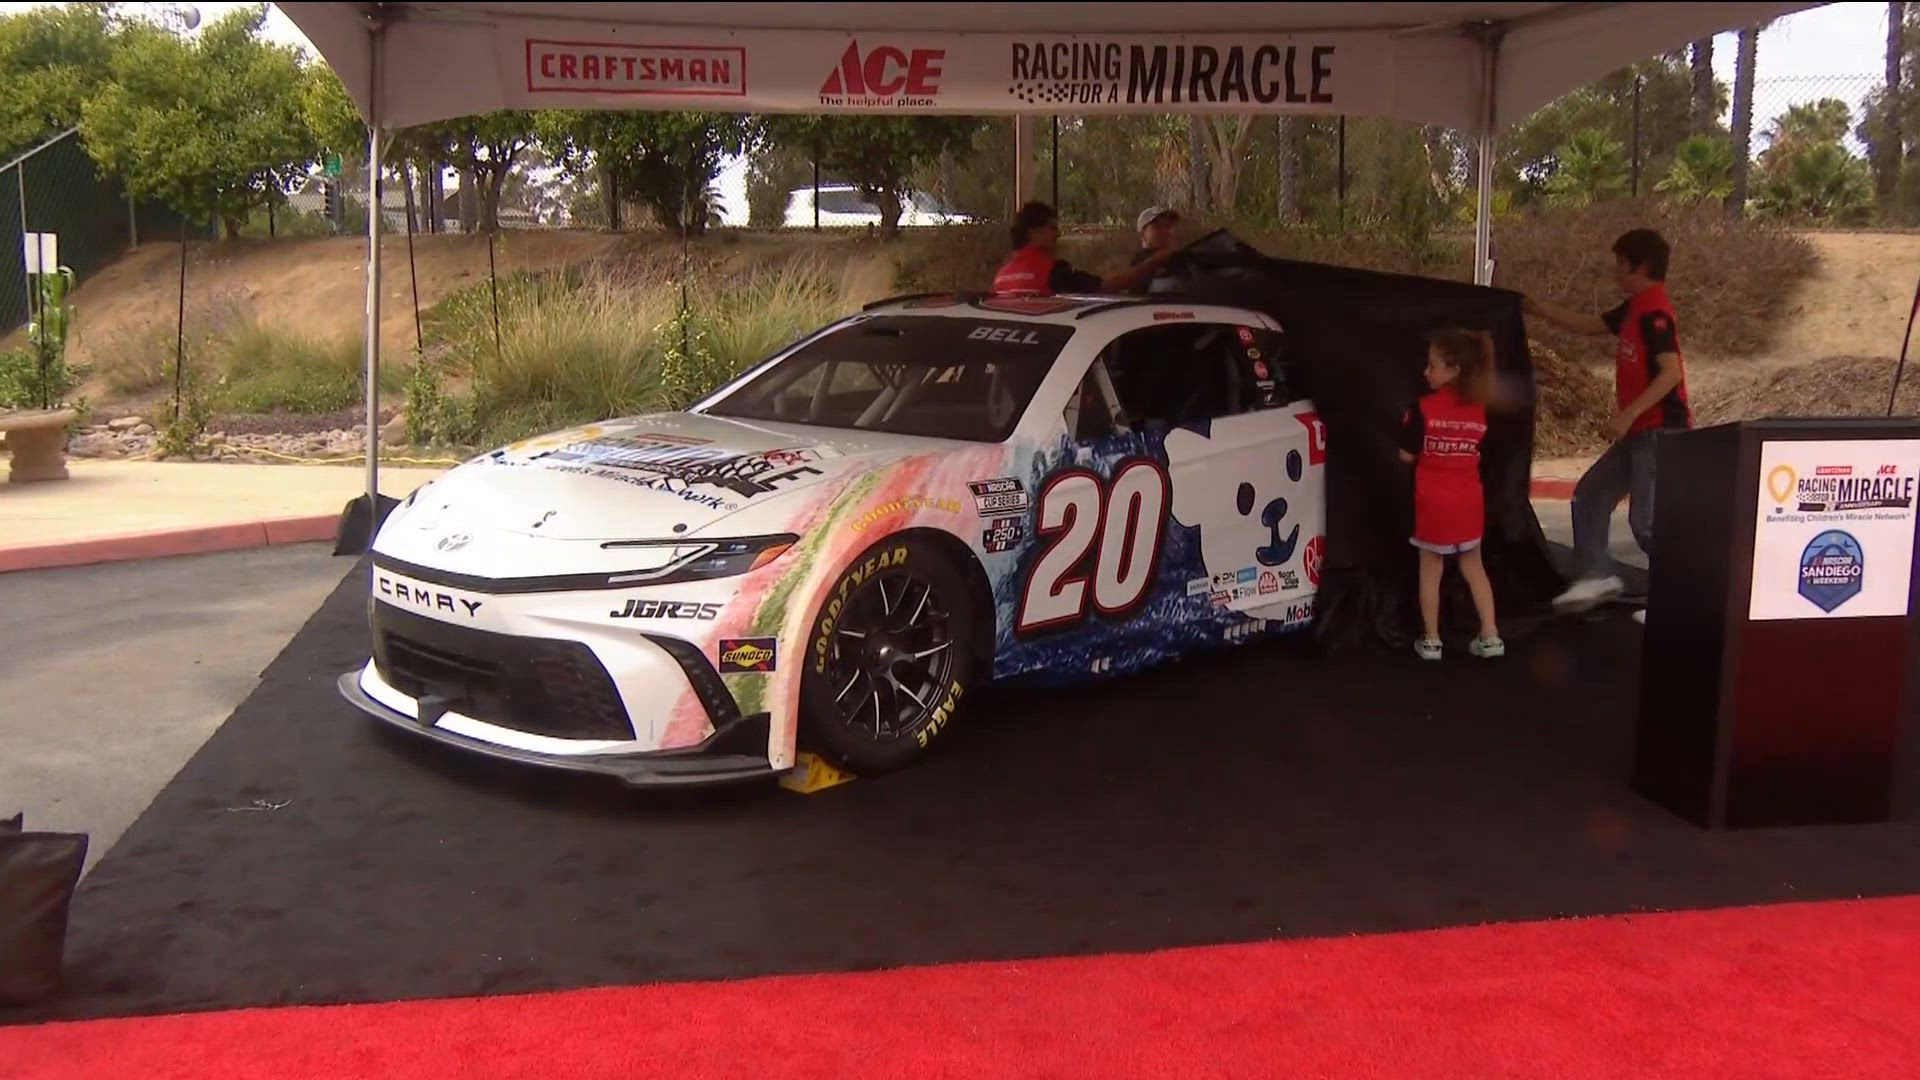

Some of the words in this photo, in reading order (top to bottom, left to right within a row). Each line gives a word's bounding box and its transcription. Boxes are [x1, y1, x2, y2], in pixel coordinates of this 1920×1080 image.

[540, 53, 731, 85] CRAFTSMAN
[819, 38, 946, 96] ACE
[1012, 42, 1122, 81] RACING
[1126, 44, 1336, 105] MIRACLE
[819, 95, 844, 107] The
[847, 96, 894, 108] helpful
[897, 98, 937, 107] place.
[1069, 82, 1101, 104] FOR
[1107, 82, 1119, 104] A
[967, 326, 1040, 345] BELL
[1877, 464, 1897, 476] ACE
[987, 481, 1017, 492] NASCAR
[1797, 477, 1837, 493] RACING
[1838, 477, 1914, 501] MIRACLE
[984, 496, 997, 508] CUP
[998, 494, 1021, 506] SERIES
[1766, 515, 1805, 523] Benefiting
[1806, 512, 1844, 522] Children's
[1846, 512, 1873, 521] Miracle
[992, 527, 1016, 543] 250
[1018, 460, 1165, 630] 20
[1801, 566, 1824, 578] SAN
[1825, 565, 1861, 577] DIEGO
[1813, 577, 1850, 585] WEEKEND
[610, 599, 727, 621] JGR35
[815, 547, 908, 674] GOODYEAR
[721, 649, 776, 664] SUNOCO
[917, 681, 963, 748] EAGLE
